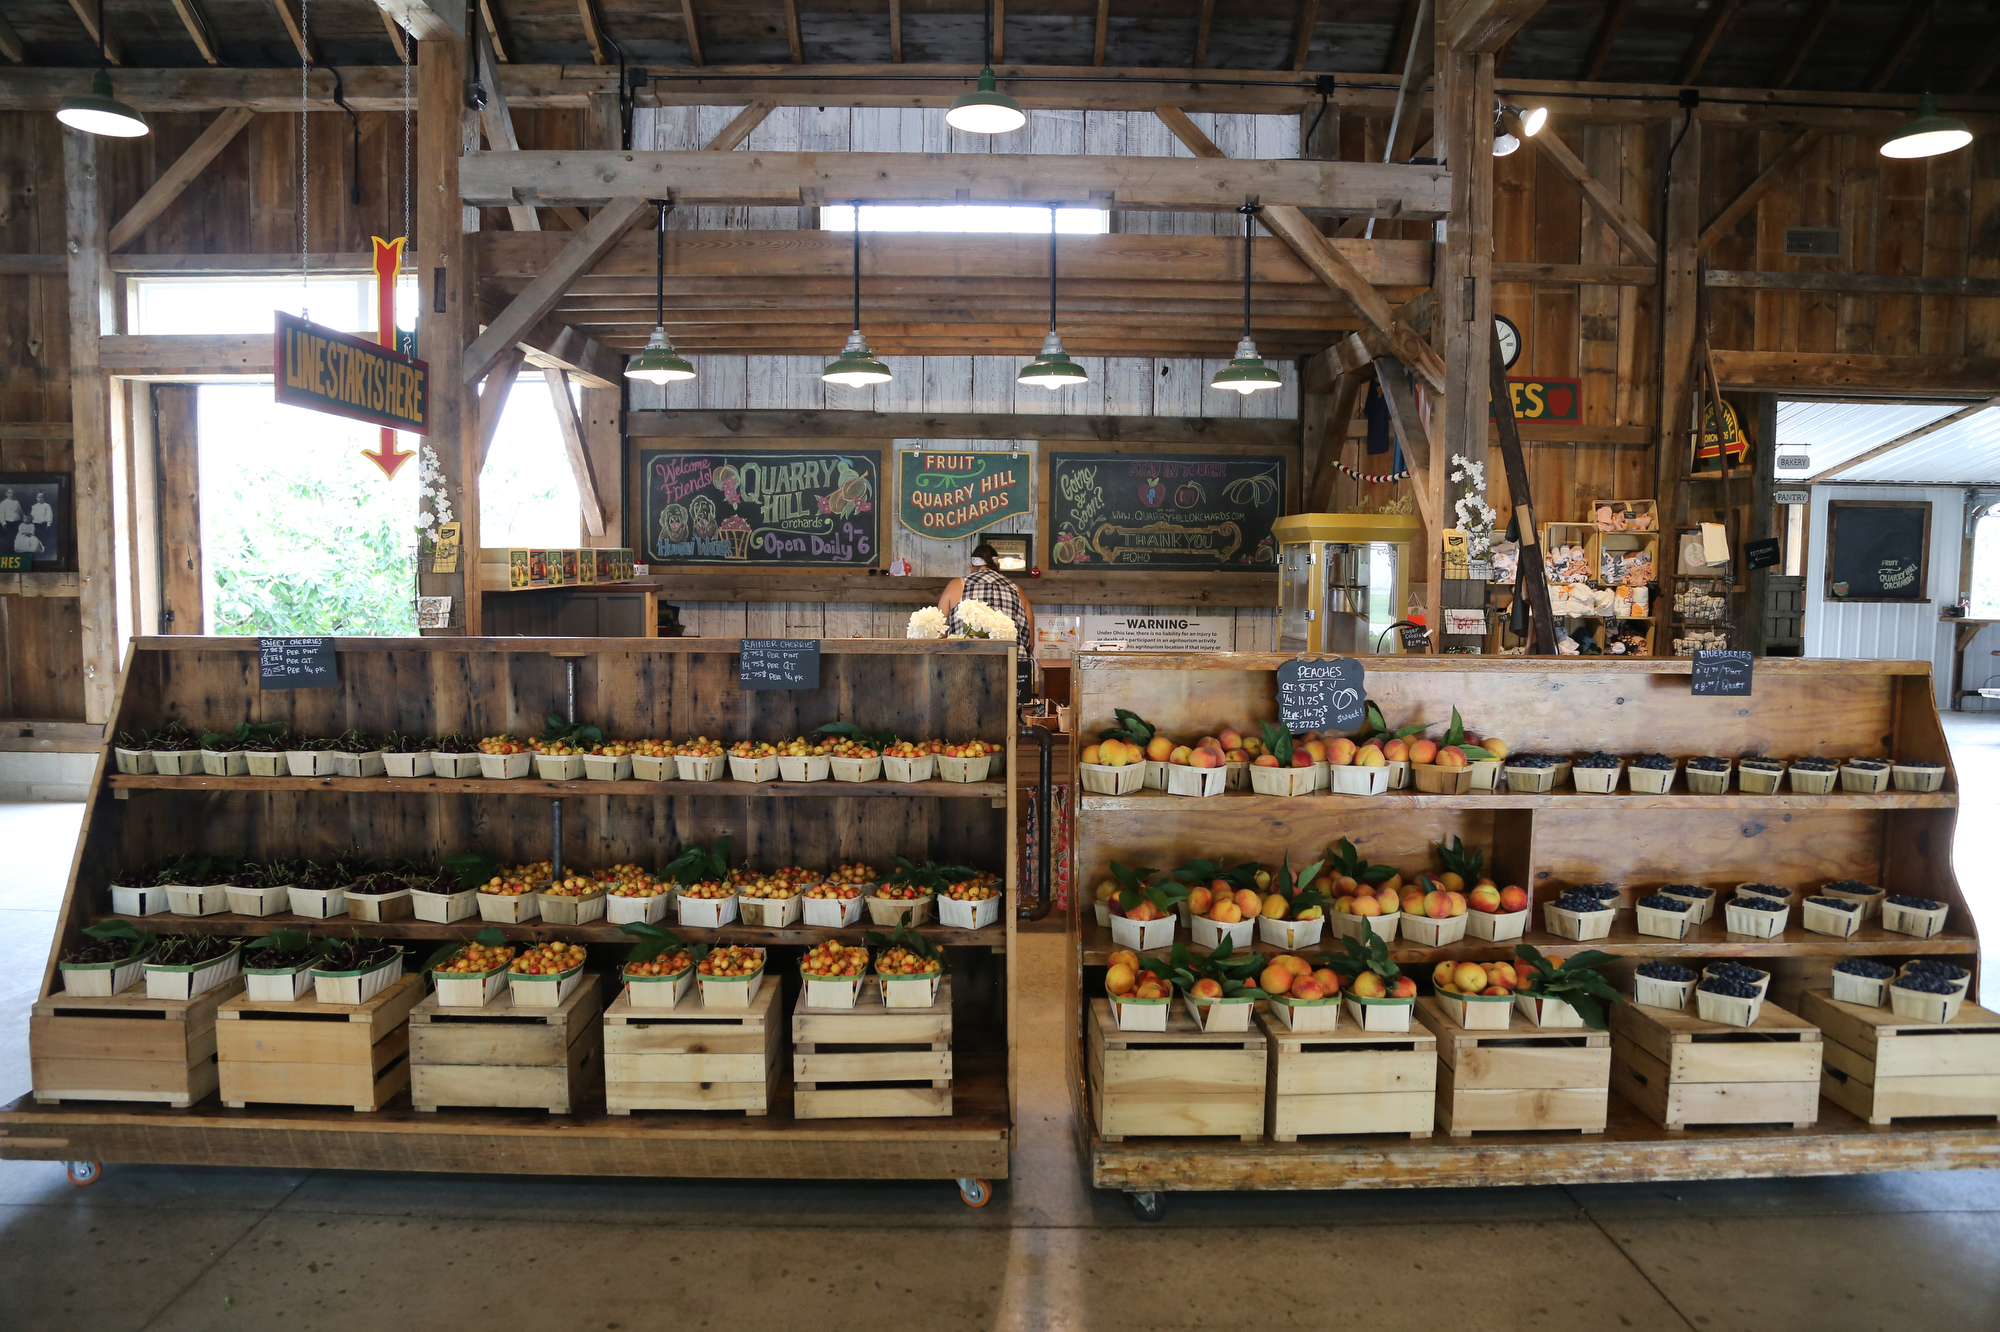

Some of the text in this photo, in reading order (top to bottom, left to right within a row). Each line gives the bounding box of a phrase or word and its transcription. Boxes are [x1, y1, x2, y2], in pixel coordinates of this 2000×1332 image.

[287, 327, 424, 422] LINE STARTS HERE
[925, 455, 975, 471] FRUIT
[1129, 461, 1226, 477] STAY IN TOUCH!
[1780, 458, 1806, 466] BAKERY
[656, 457, 711, 484] Welcome
[661, 468, 713, 504] Friends!
[740, 459, 838, 504] QUARRY
[911, 470, 1016, 509] QUARRY HILL
[1060, 465, 1097, 501] Going
[1074, 491, 1086, 509] so
[1777, 493, 1806, 501] PANTRY
[761, 491, 810, 523] HILL
[922, 491, 1009, 529] ORCHARDS
[781, 517, 823, 529] orchards
[764, 532, 806, 558] Open
[811, 532, 853, 561] Daily
[1119, 533, 1212, 549] THANK YOU
[0, 557, 21, 569] HES
[1127, 619, 1188, 629] WARNING
[744, 640, 814, 649] RAINIER CHERRIES
[1699, 650, 1752, 660] BLUEBERRIES
[287, 666, 300, 674] PER
[783, 661, 796, 670] QT
[1297, 665, 1342, 679] PEACHES
[769, 673, 782, 681] PER
